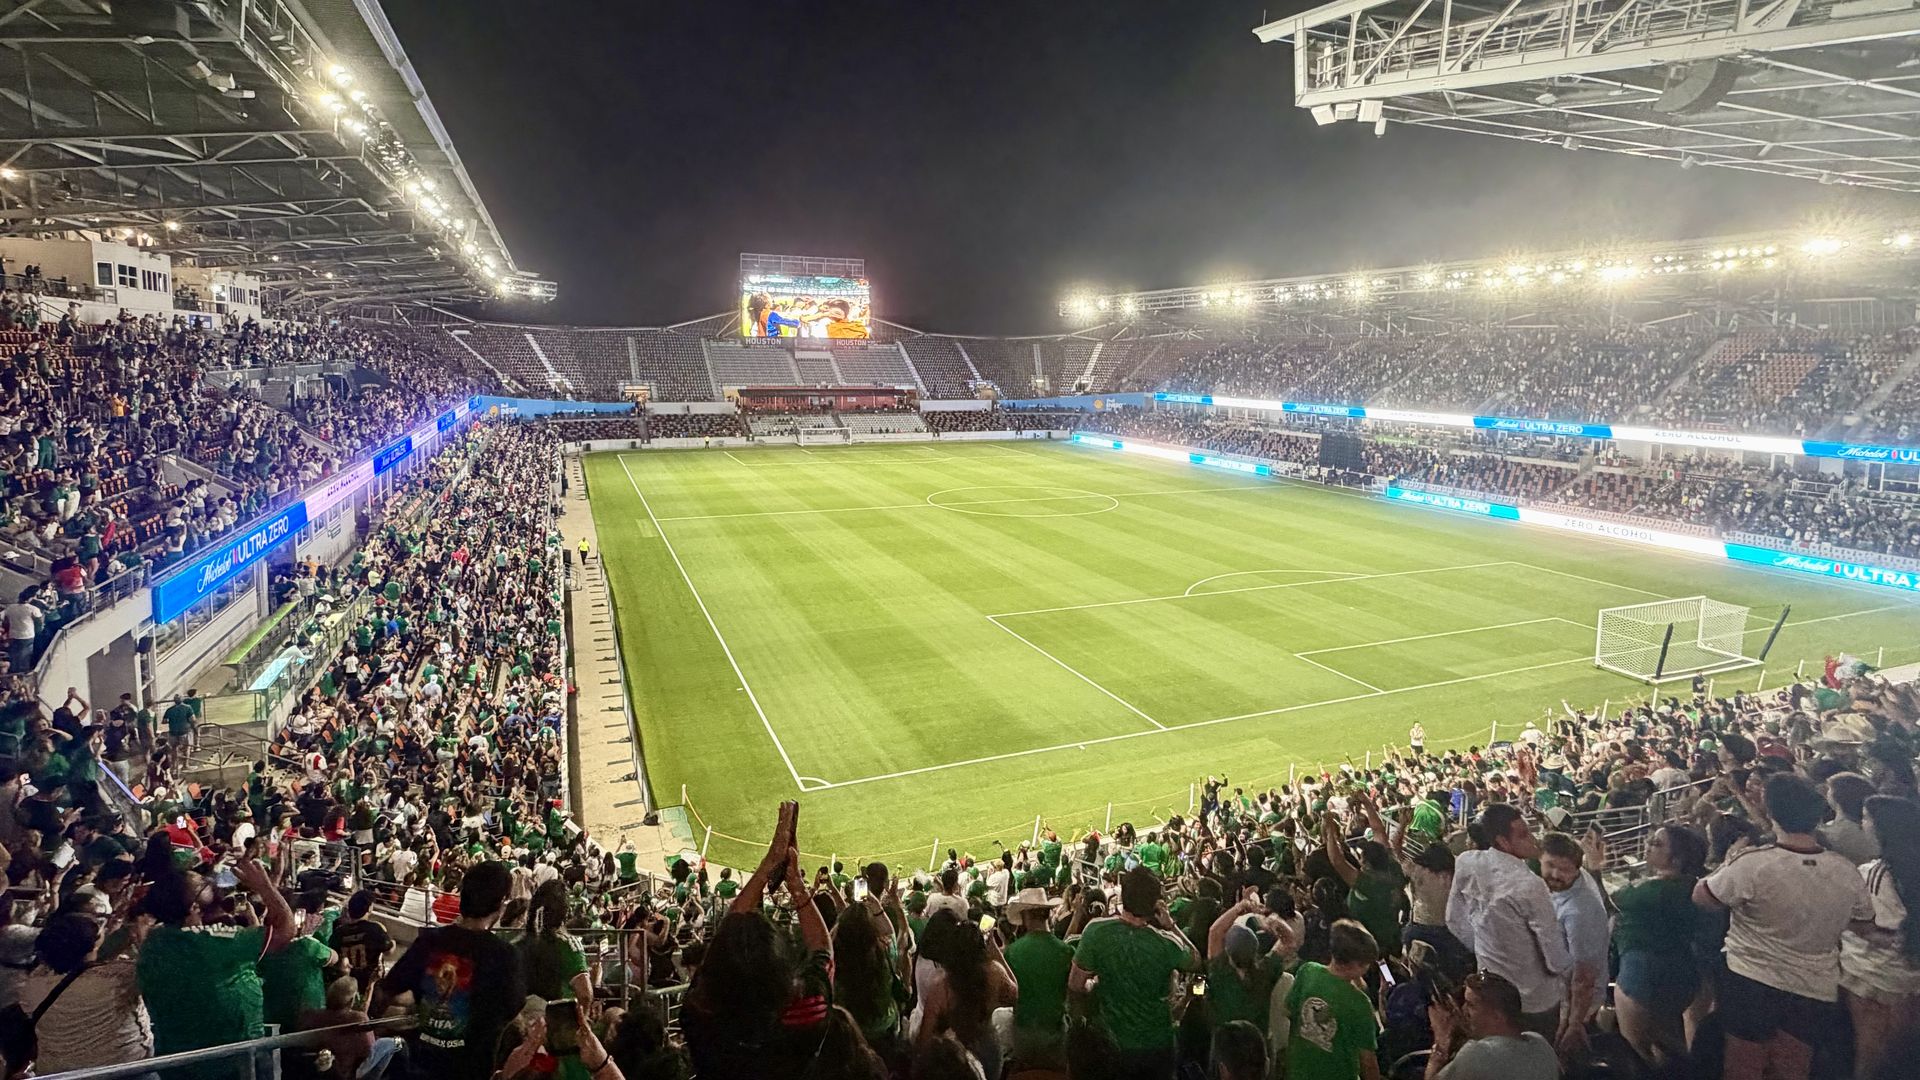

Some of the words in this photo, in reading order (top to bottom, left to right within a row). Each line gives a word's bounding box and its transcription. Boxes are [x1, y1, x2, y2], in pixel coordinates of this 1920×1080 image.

[745, 337, 782, 345] HOUSTON
[1525, 422, 1556, 432] ULTRA
[1556, 424, 1583, 434] ZERO
[1837, 445, 1890, 459] Michelob
[1430, 496, 1461, 508] ULTRA
[1463, 501, 1491, 513] ZERO
[1565, 519, 1593, 530] ZERO
[1598, 524, 1655, 541] ALCOHOL
[197, 550, 233, 592] Michelob
[238, 528, 268, 563] ULTRA
[268, 515, 289, 543] ZERO
[1773, 553, 1831, 572] Michelob
[1843, 564, 1911, 587] ULTRA
[428, 1018, 454, 1030] FIFA
